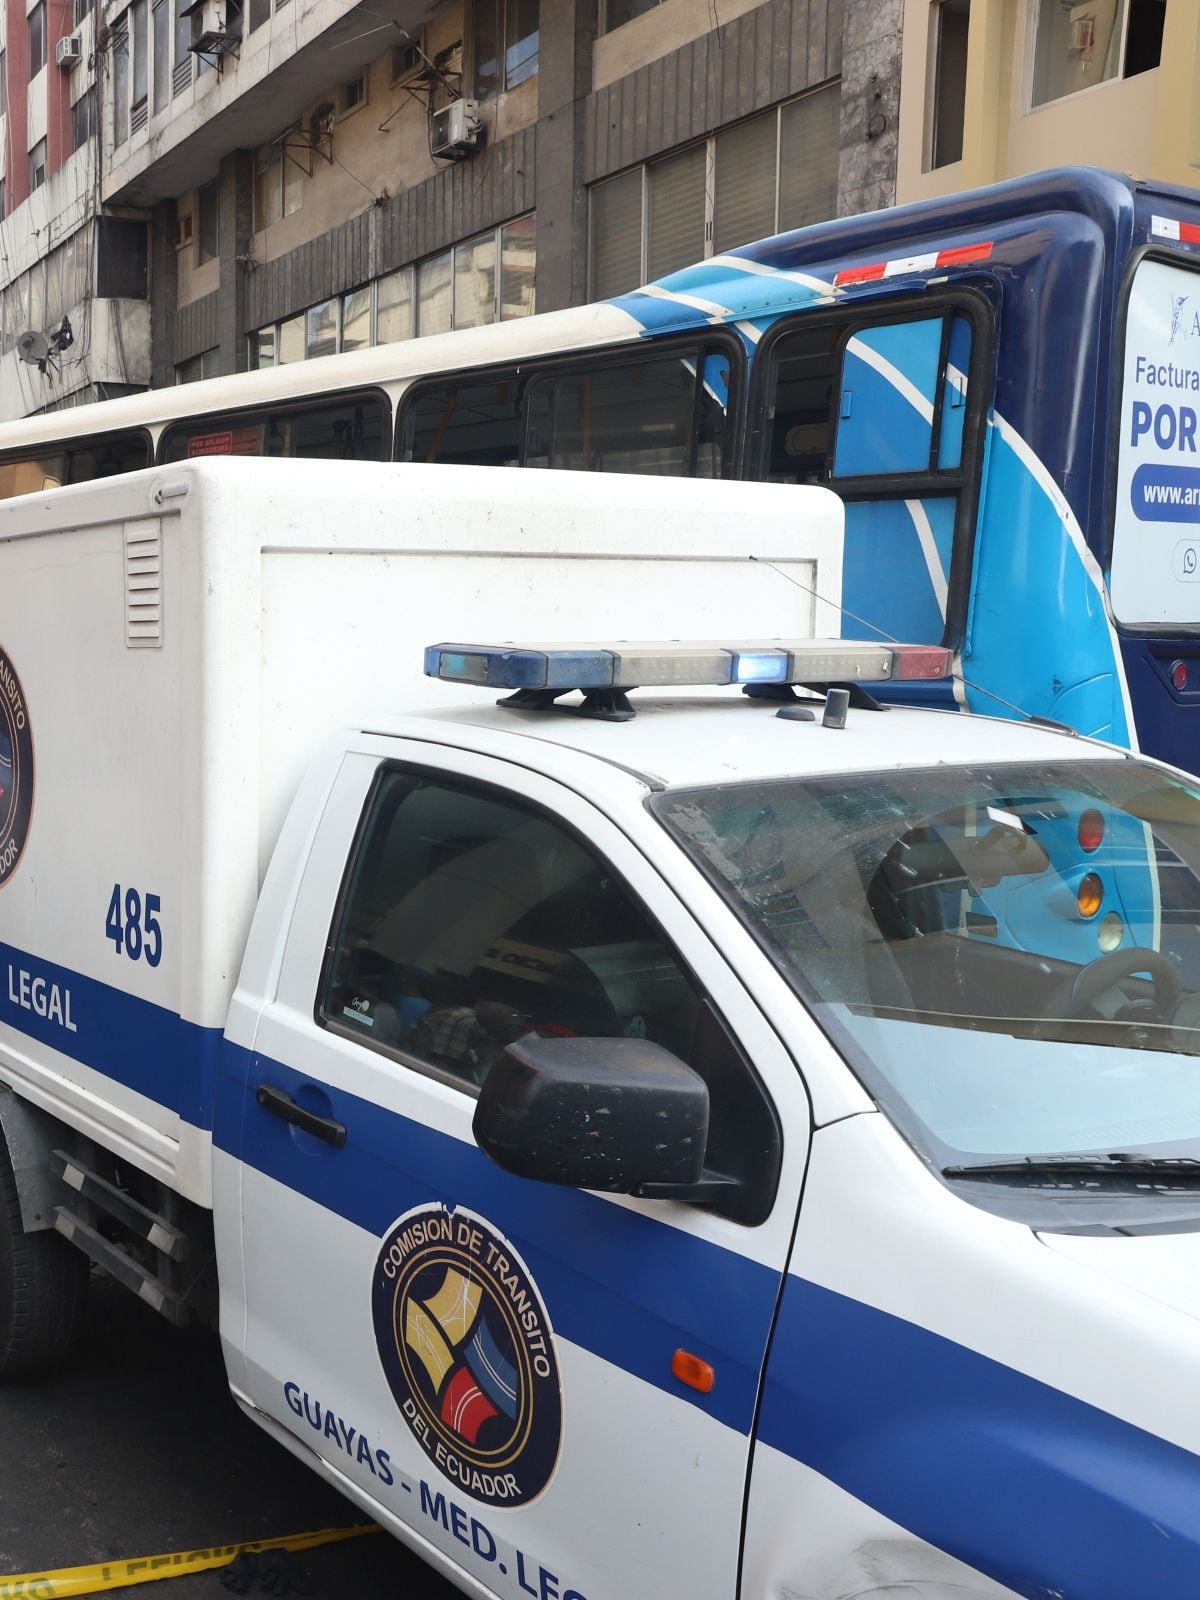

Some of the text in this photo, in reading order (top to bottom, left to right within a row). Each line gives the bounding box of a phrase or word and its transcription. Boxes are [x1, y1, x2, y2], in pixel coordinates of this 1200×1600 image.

[1136, 356, 1200, 391] Factura
[1131, 401, 1197, 452] POR
[105, 883, 162, 968] 485
[8, 964, 77, 1032] LEGAL
[383, 1217, 551, 1378] COMISION DE TRANSITO
[402, 1397, 522, 1498] DEL ECUADOR
[284, 1381, 394, 1486] GUAYAS
[419, 1479, 508, 1575] MED.
[516, 1550, 588, 1600] LE
